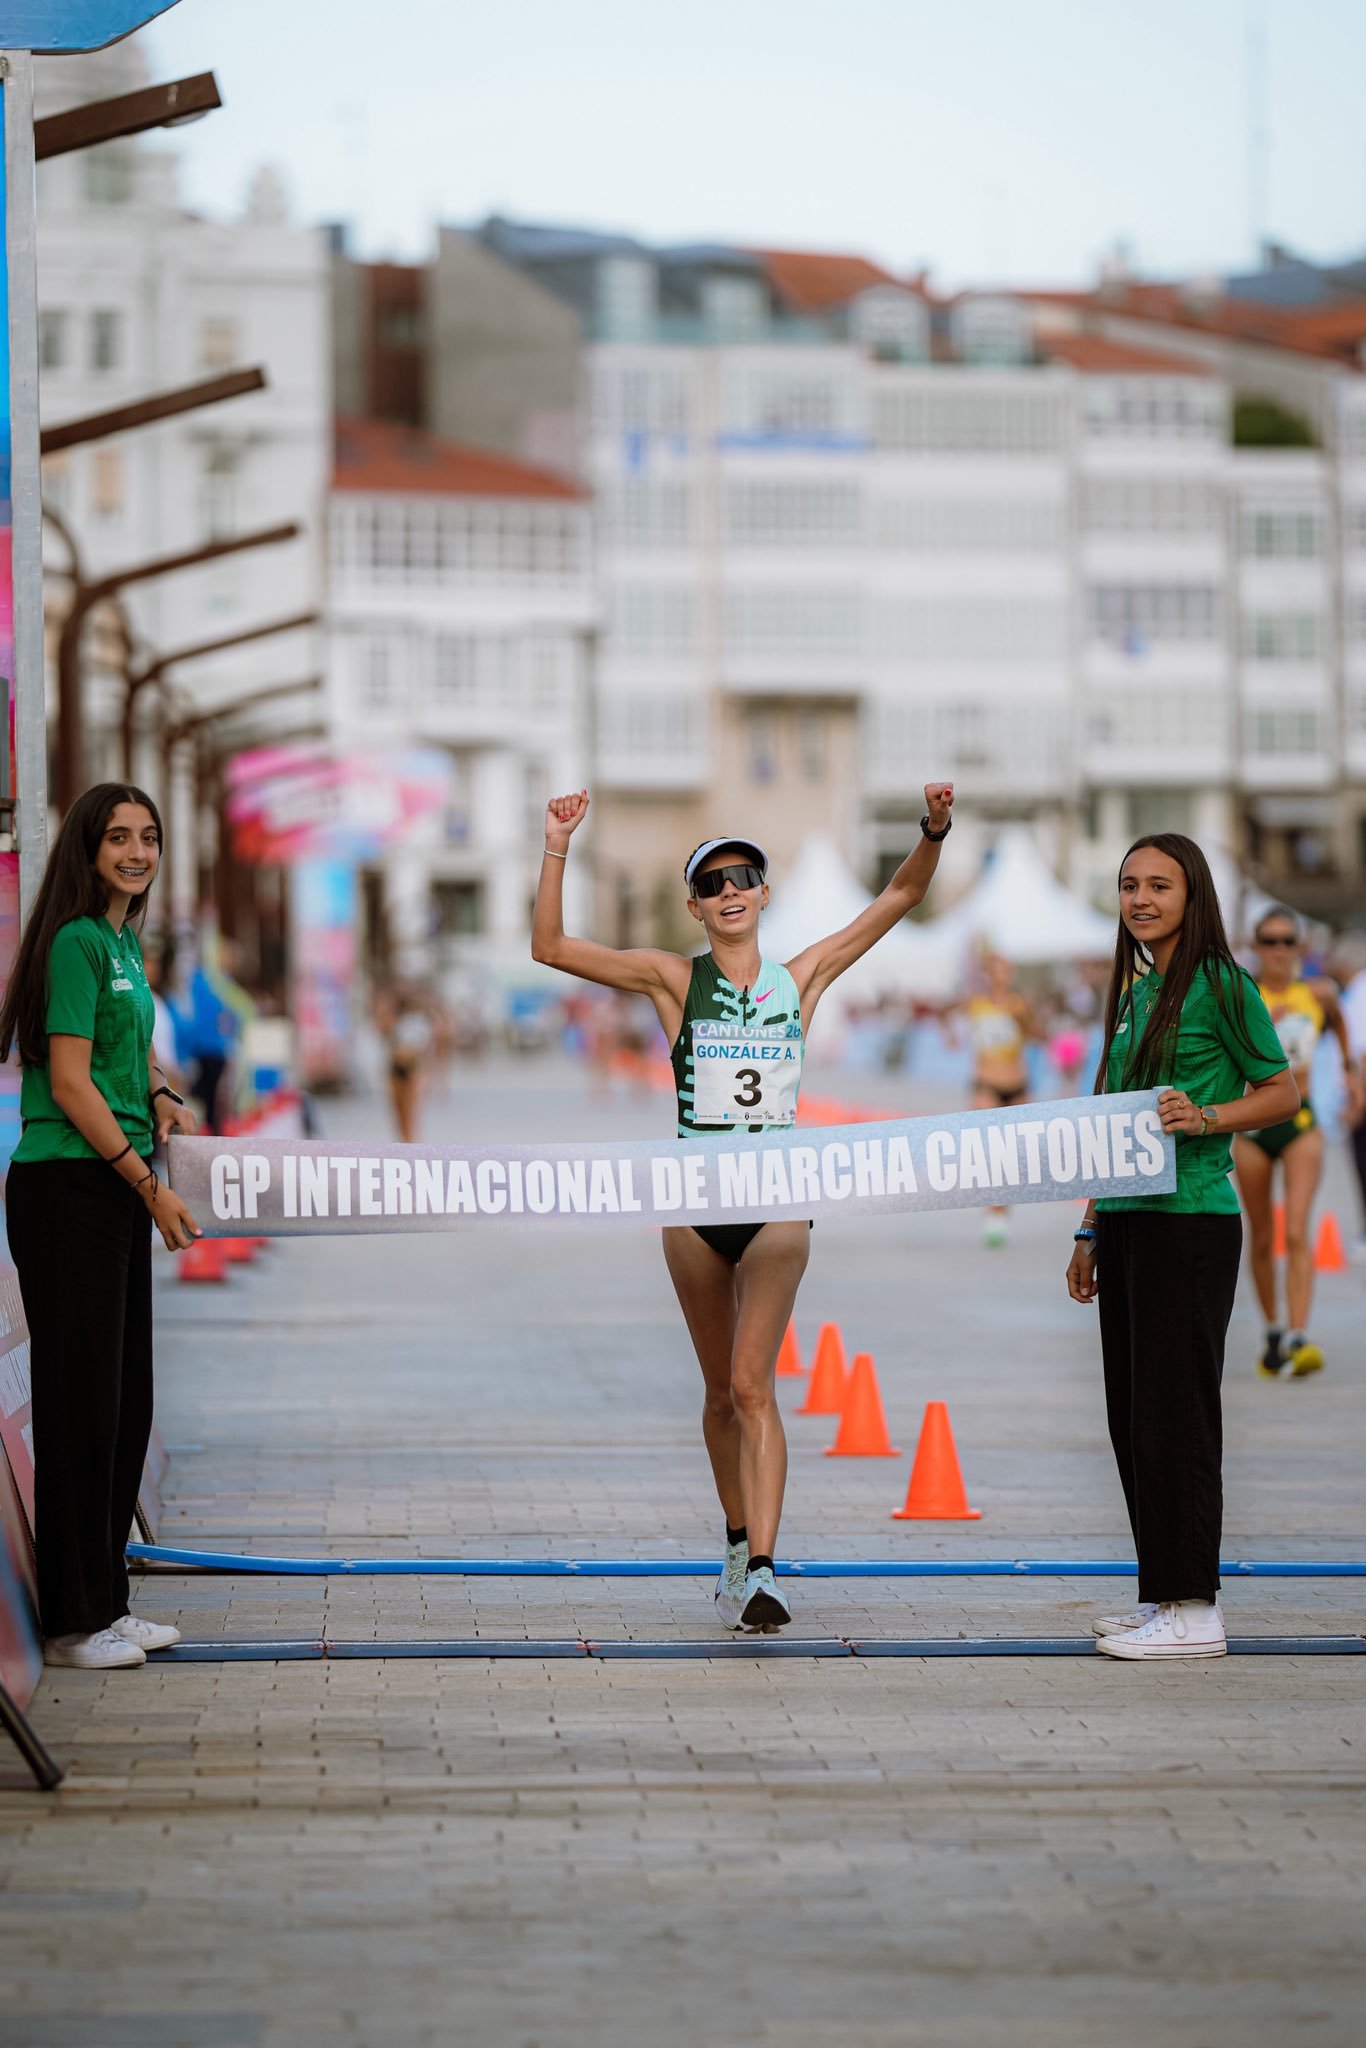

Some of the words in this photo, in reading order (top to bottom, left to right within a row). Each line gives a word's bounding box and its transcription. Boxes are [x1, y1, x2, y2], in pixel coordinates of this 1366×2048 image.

[697, 1043, 781, 1059] GONZÁLEZ
[784, 1047, 795, 1060] A.
[734, 1069, 762, 1107] 3
[211, 1154, 271, 1220] GP
[283, 1155, 641, 1217] INTERNACIONAL
[651, 1155, 708, 1210] DE
[719, 1136, 918, 1207] MARCHA
[926, 1111, 1165, 1192] CANTONES
